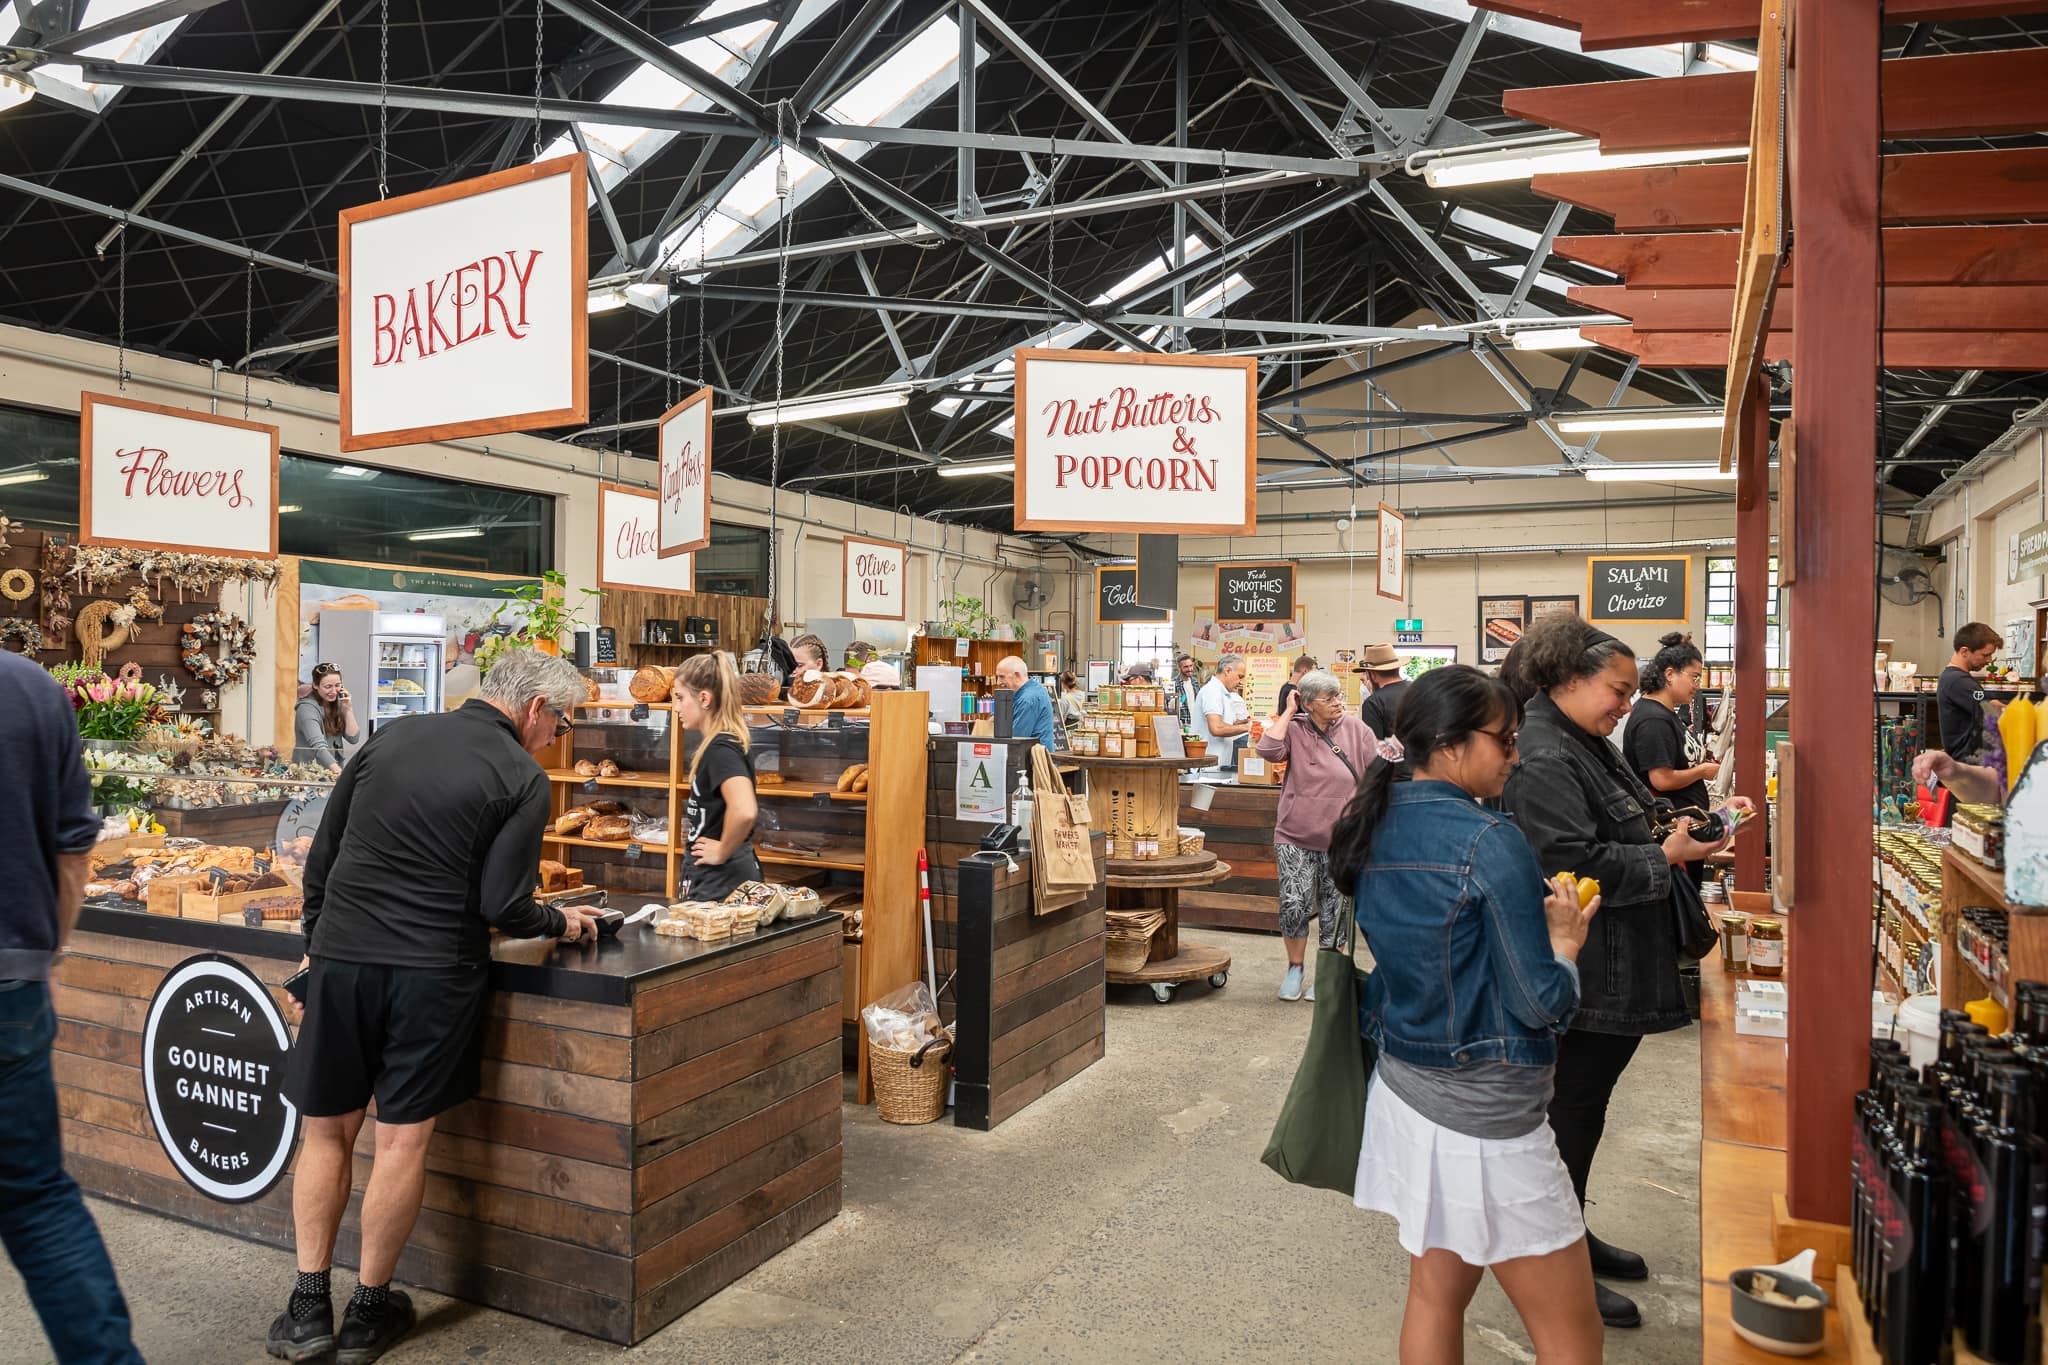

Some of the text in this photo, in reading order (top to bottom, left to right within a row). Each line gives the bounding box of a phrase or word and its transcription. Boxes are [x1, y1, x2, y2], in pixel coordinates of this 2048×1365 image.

[372, 249, 545, 367] BAKERY
[1041, 387, 1222, 438] Nut Butters
[1172, 425, 1198, 456] &
[115, 446, 253, 508] Flowers
[1054, 454, 1218, 492] POPCORN
[856, 553, 896, 577] Olive
[1247, 569, 1267, 580] Fresh
[1607, 567, 1668, 583] SALAMI
[863, 578, 889, 596] OIL
[1228, 579, 1283, 594] SMOOTHIES
[1634, 582, 1643, 591] &
[1232, 597, 1277, 614] JUICE
[1608, 594, 1667, 612] Chorizo
[1221, 641, 1274, 654] Lalele
[969, 760, 993, 789] A
[185, 990, 252, 1025] ARTISAN
[168, 1046, 270, 1086] GOURMET
[176, 1078, 262, 1116] GANNET
[190, 1138, 250, 1171] BAKERS
